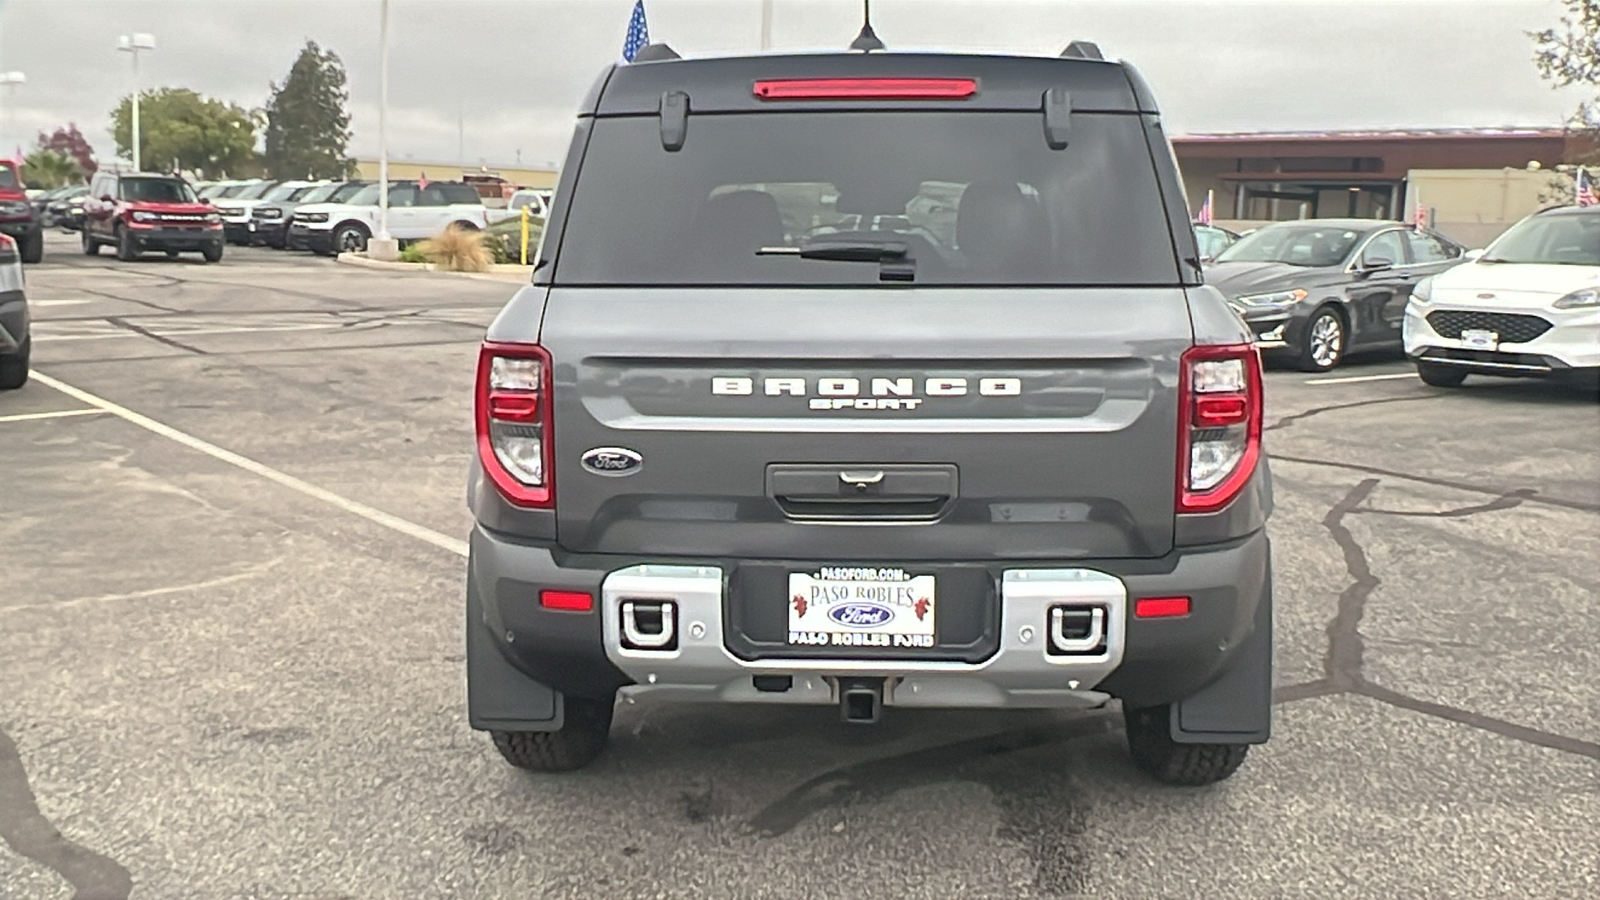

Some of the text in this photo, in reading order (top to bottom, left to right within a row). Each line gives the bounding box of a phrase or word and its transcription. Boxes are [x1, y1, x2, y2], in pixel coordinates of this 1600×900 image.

[712, 377, 1021, 395] BRONCO
[809, 398, 922, 409] SPORT
[594, 453, 628, 468] Ford
[821, 567, 903, 581] PASOFORD.COM
[811, 585, 914, 608] PASO ROBLES
[841, 606, 881, 623] Ford
[789, 632, 933, 646] PASO ROBLES FORD
